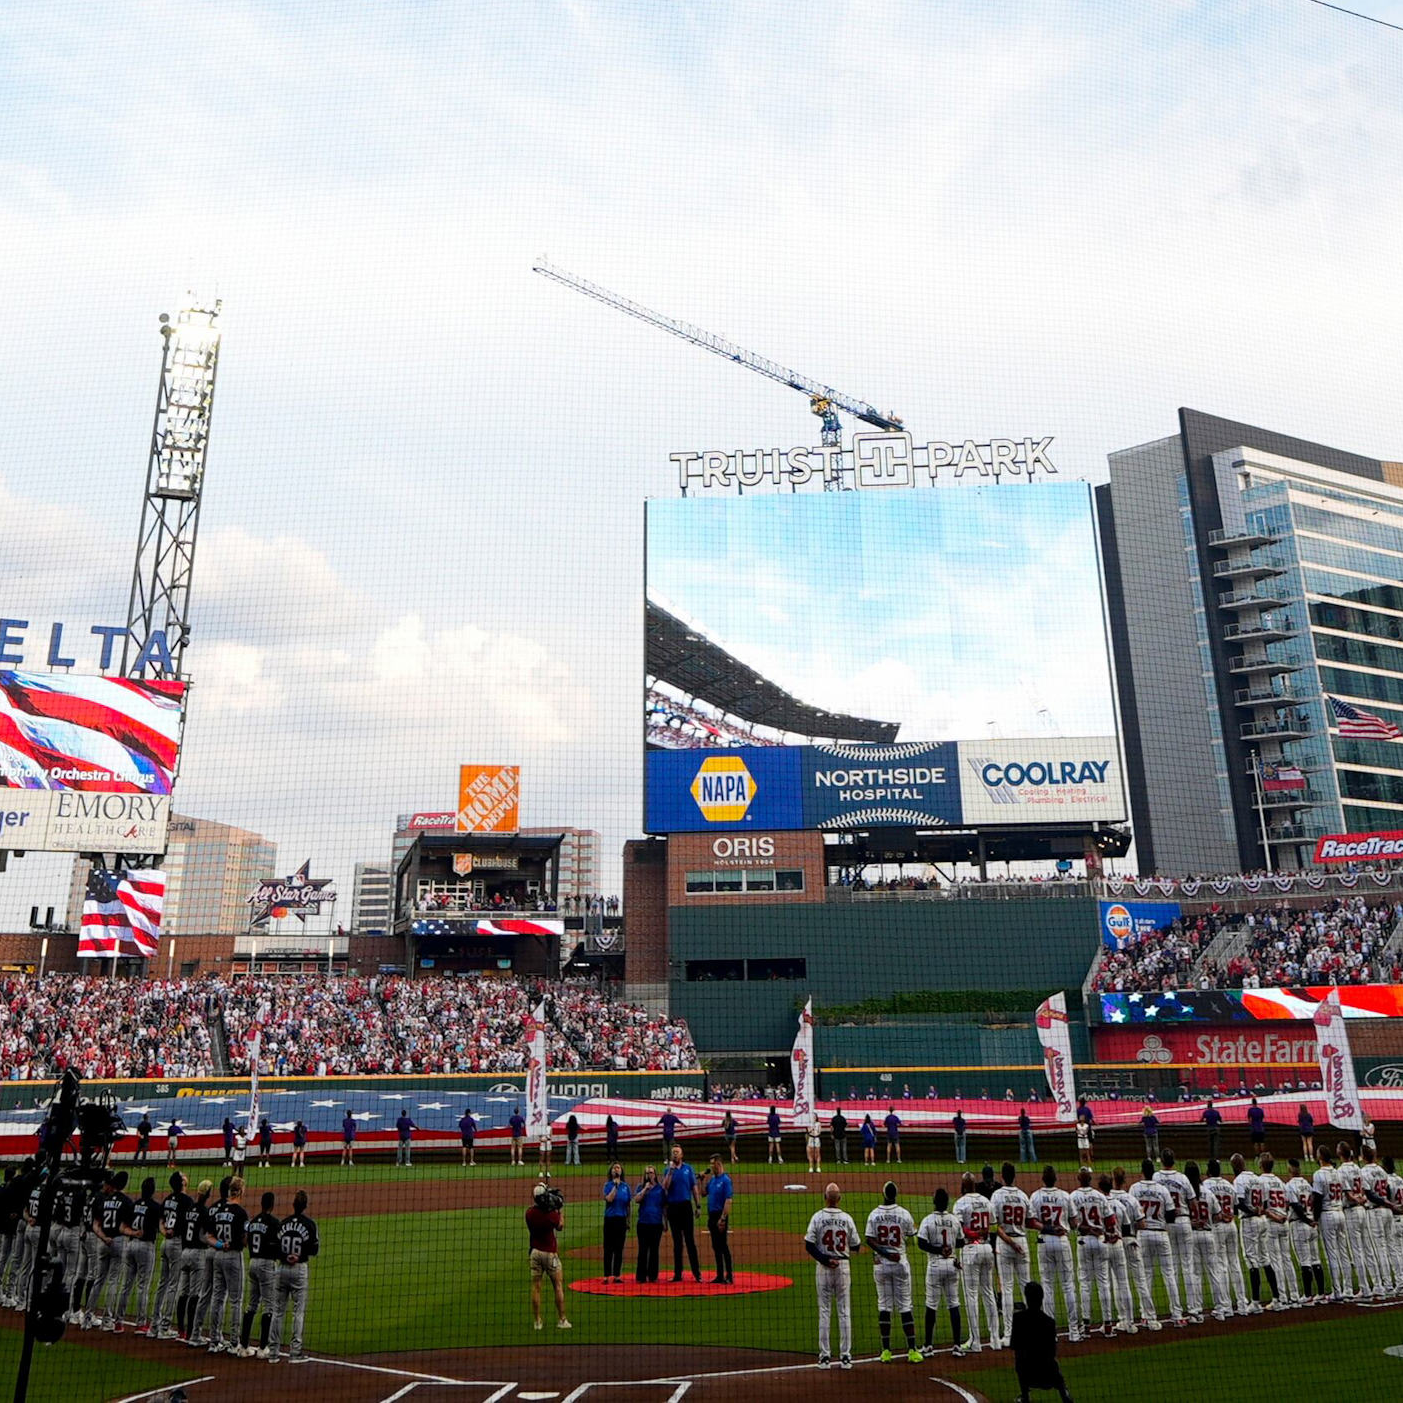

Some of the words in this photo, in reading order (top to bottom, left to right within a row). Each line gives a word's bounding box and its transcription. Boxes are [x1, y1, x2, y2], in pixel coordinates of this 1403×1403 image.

[670, 446, 842, 488] TRUIST
[927, 436, 1059, 478] PARK
[51, 767, 111, 782] Orchestra
[464, 771, 492, 797] THE
[815, 767, 947, 788] NORTHSIDE
[982, 760, 1110, 787] COOLRAY
[458, 766, 519, 831] HOME
[702, 775, 746, 803] NAPA
[839, 788, 923, 802] HOSPITAL
[57, 793, 165, 821] EMORY
[481, 789, 519, 831] DEPOT
[53, 823, 156, 838] HEALTHCARE
[712, 837, 775, 858] ORIS
[473, 857, 518, 868] CLUBHOUSE
[246, 885, 273, 904] All
[272, 885, 300, 902] Star
[300, 885, 337, 904] Game
[1108, 916, 1130, 927] Gulf
[651, 1087, 677, 1099] PAPA
[1268, 1190, 1285, 1208] 55
[103, 1209, 117, 1228] 21
[1003, 1205, 1024, 1226] 28
[1041, 1205, 1063, 1226] 27
[1079, 1205, 1100, 1227] 14
[1140, 1200, 1161, 1220] 77
[186, 1222, 194, 1241] 6
[822, 1217, 846, 1228] SNITKER
[971, 1211, 990, 1232] 20
[252, 1234, 260, 1253] 9
[281, 1235, 302, 1256] 86
[822, 1229, 847, 1252] 43
[877, 1225, 901, 1247] 23
[941, 1228, 947, 1247] 1
